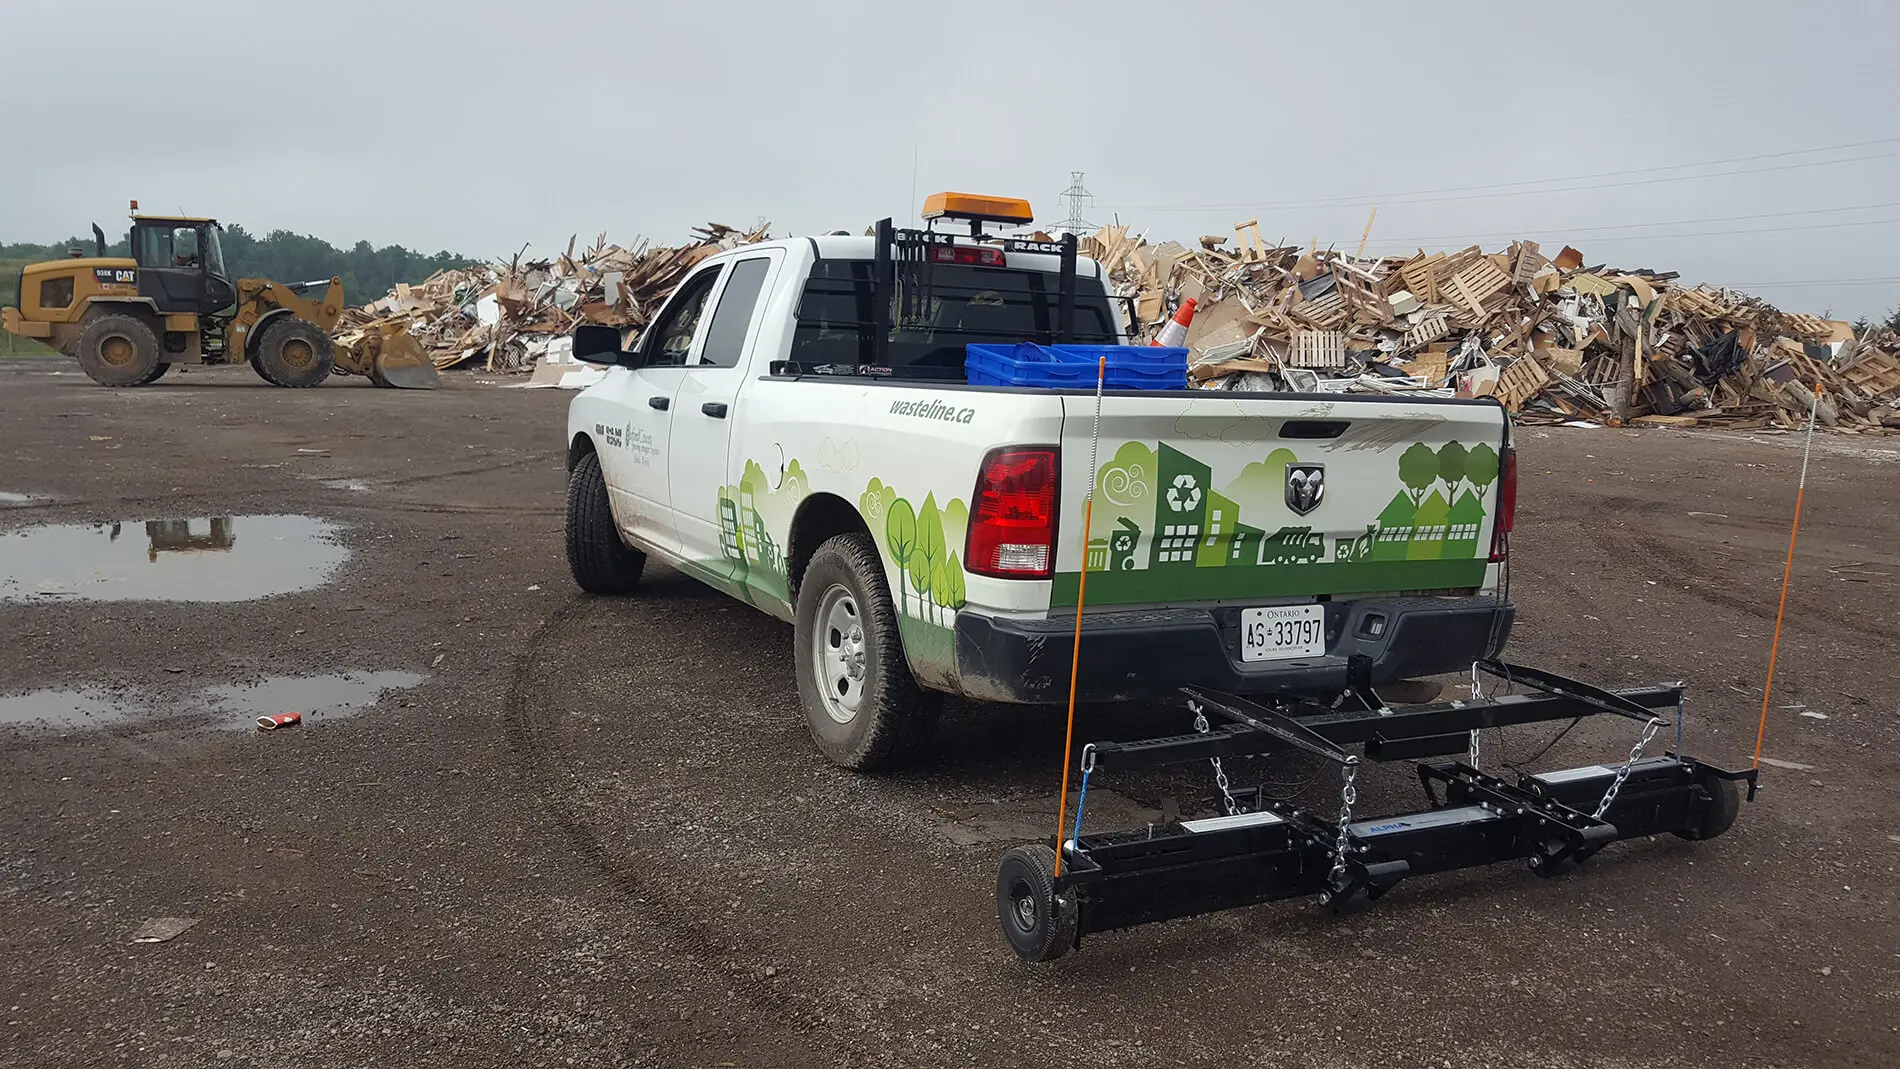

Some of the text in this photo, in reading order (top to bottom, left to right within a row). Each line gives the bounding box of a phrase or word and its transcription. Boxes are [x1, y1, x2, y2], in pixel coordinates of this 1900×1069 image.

[897, 232, 948, 244] BCK
[1014, 242, 1064, 252] RACK
[116, 270, 135, 281] CAT
[889, 399, 975, 424] wasteline.ca
[1267, 610, 1300, 620] ONTARIO
[1247, 620, 1321, 648] AS 33797
